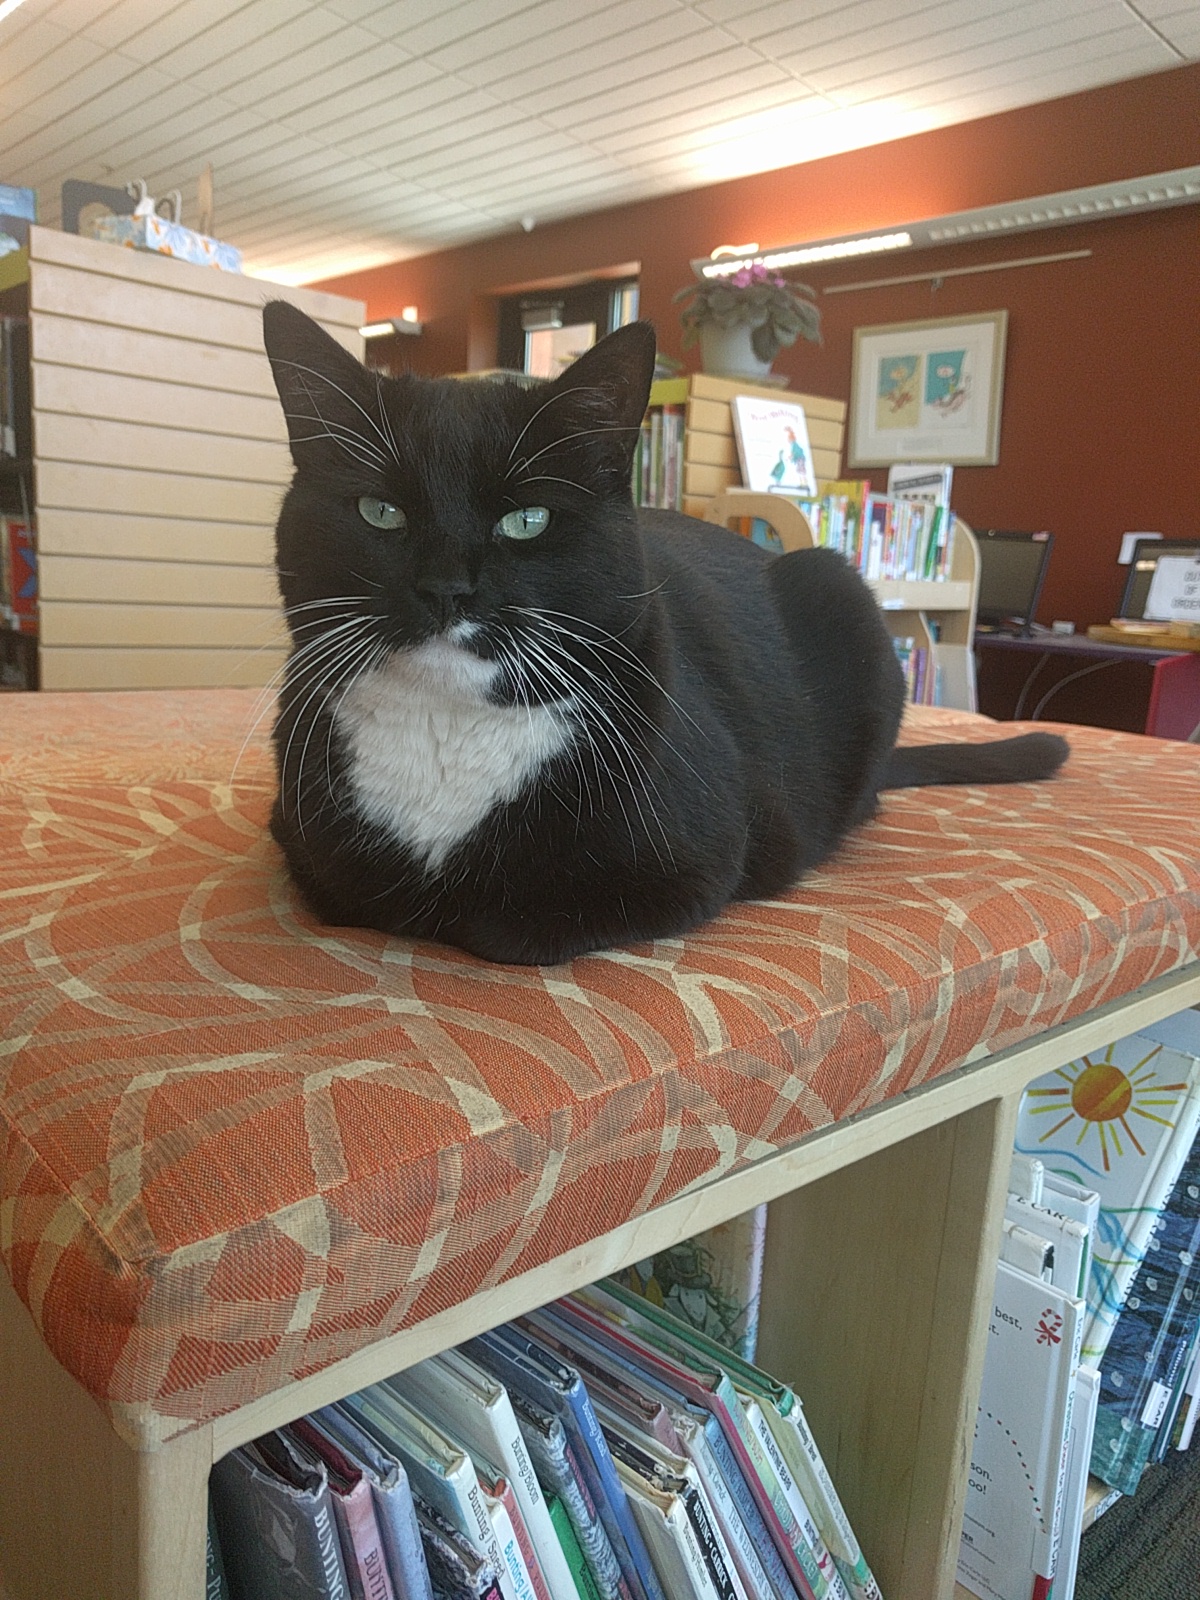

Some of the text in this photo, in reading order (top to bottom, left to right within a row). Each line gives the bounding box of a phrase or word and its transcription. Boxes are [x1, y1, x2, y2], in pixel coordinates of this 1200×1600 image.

[994, 1306, 1022, 1331] best,
[468, 1486, 489, 1541] Bunting
[314, 1505, 345, 1600] BUNTING
